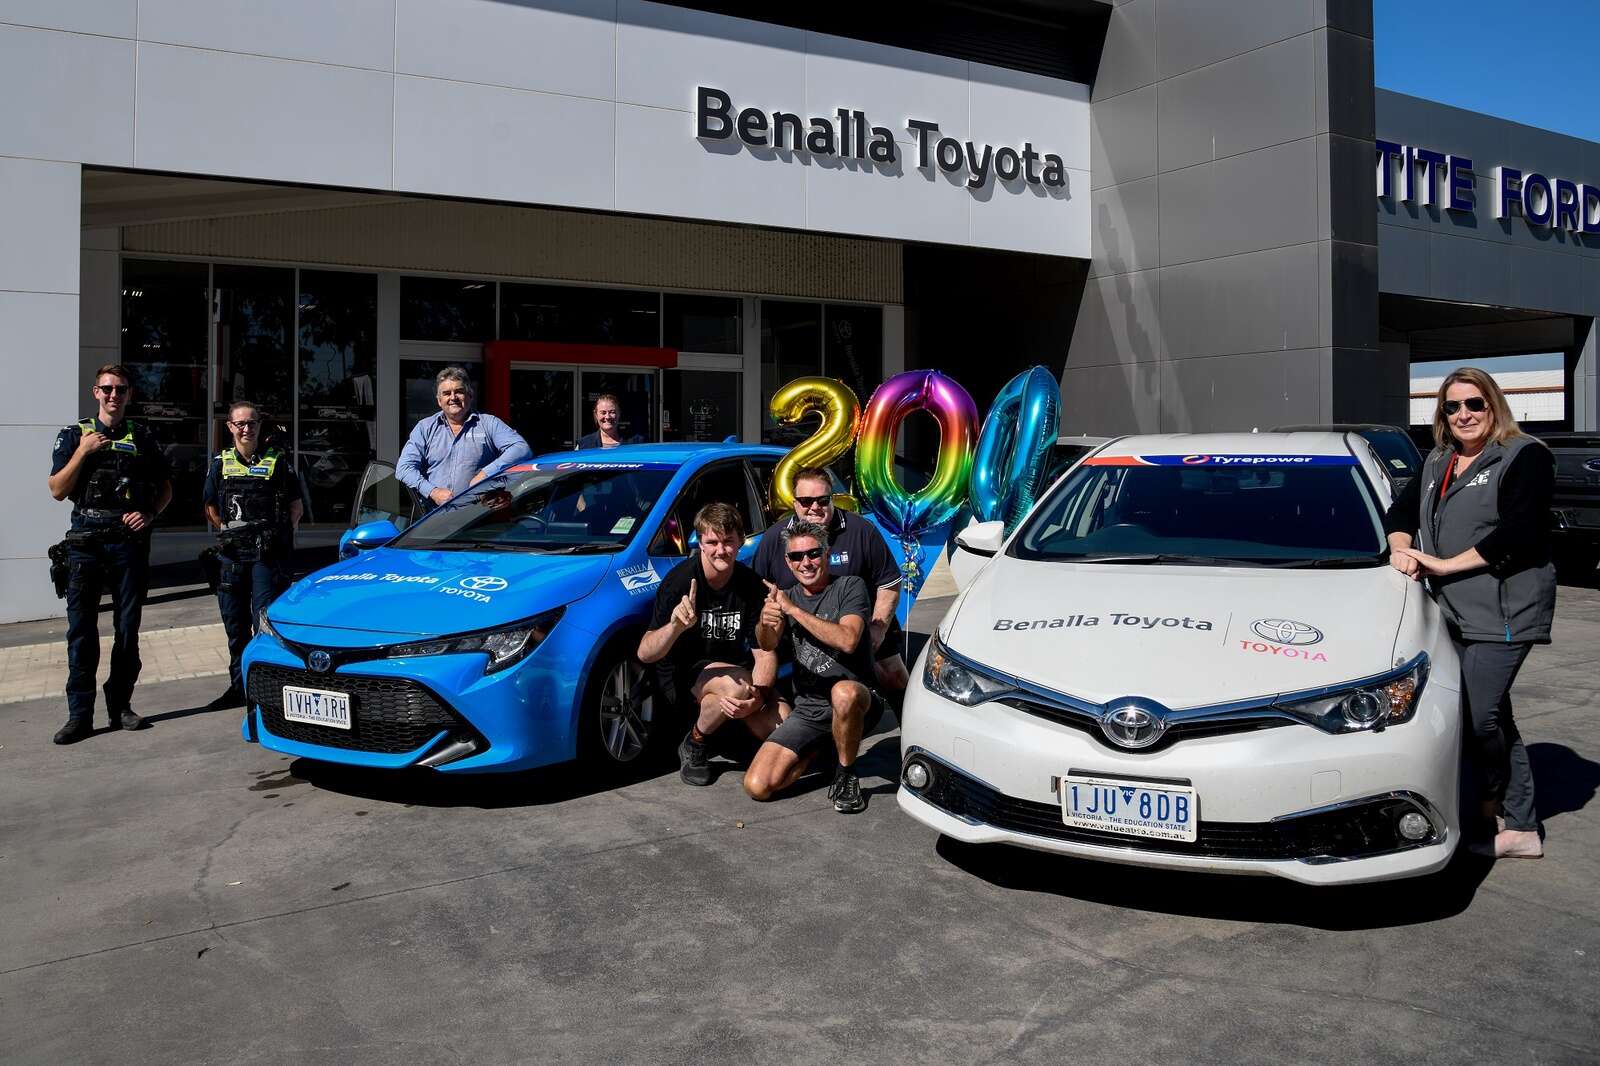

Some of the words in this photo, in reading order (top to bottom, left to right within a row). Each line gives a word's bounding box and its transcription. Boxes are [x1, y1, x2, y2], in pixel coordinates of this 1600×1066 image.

[697, 86, 897, 163] Benalla
[908, 119, 1066, 188] Toyota
[1501, 166, 1600, 234] FORD
[1212, 456, 1312, 464] Tyrepower
[380, 573, 439, 583] Toyota
[616, 563, 648, 577] BENALLA
[440, 586, 491, 603] TOYOTA
[993, 615, 1100, 631] Benalla
[1109, 613, 1213, 631] Toyota
[289, 693, 312, 715] 1VH
[324, 698, 347, 720] 1RH
[1071, 785, 1117, 815] 1JU
[1139, 792, 1189, 824] 8DB
[1071, 811, 1103, 821] VICTORIA
[1109, 816, 1121, 824] THE
[1124, 819, 1163, 829] EDUCATION
[1164, 824, 1186, 832] STATE
